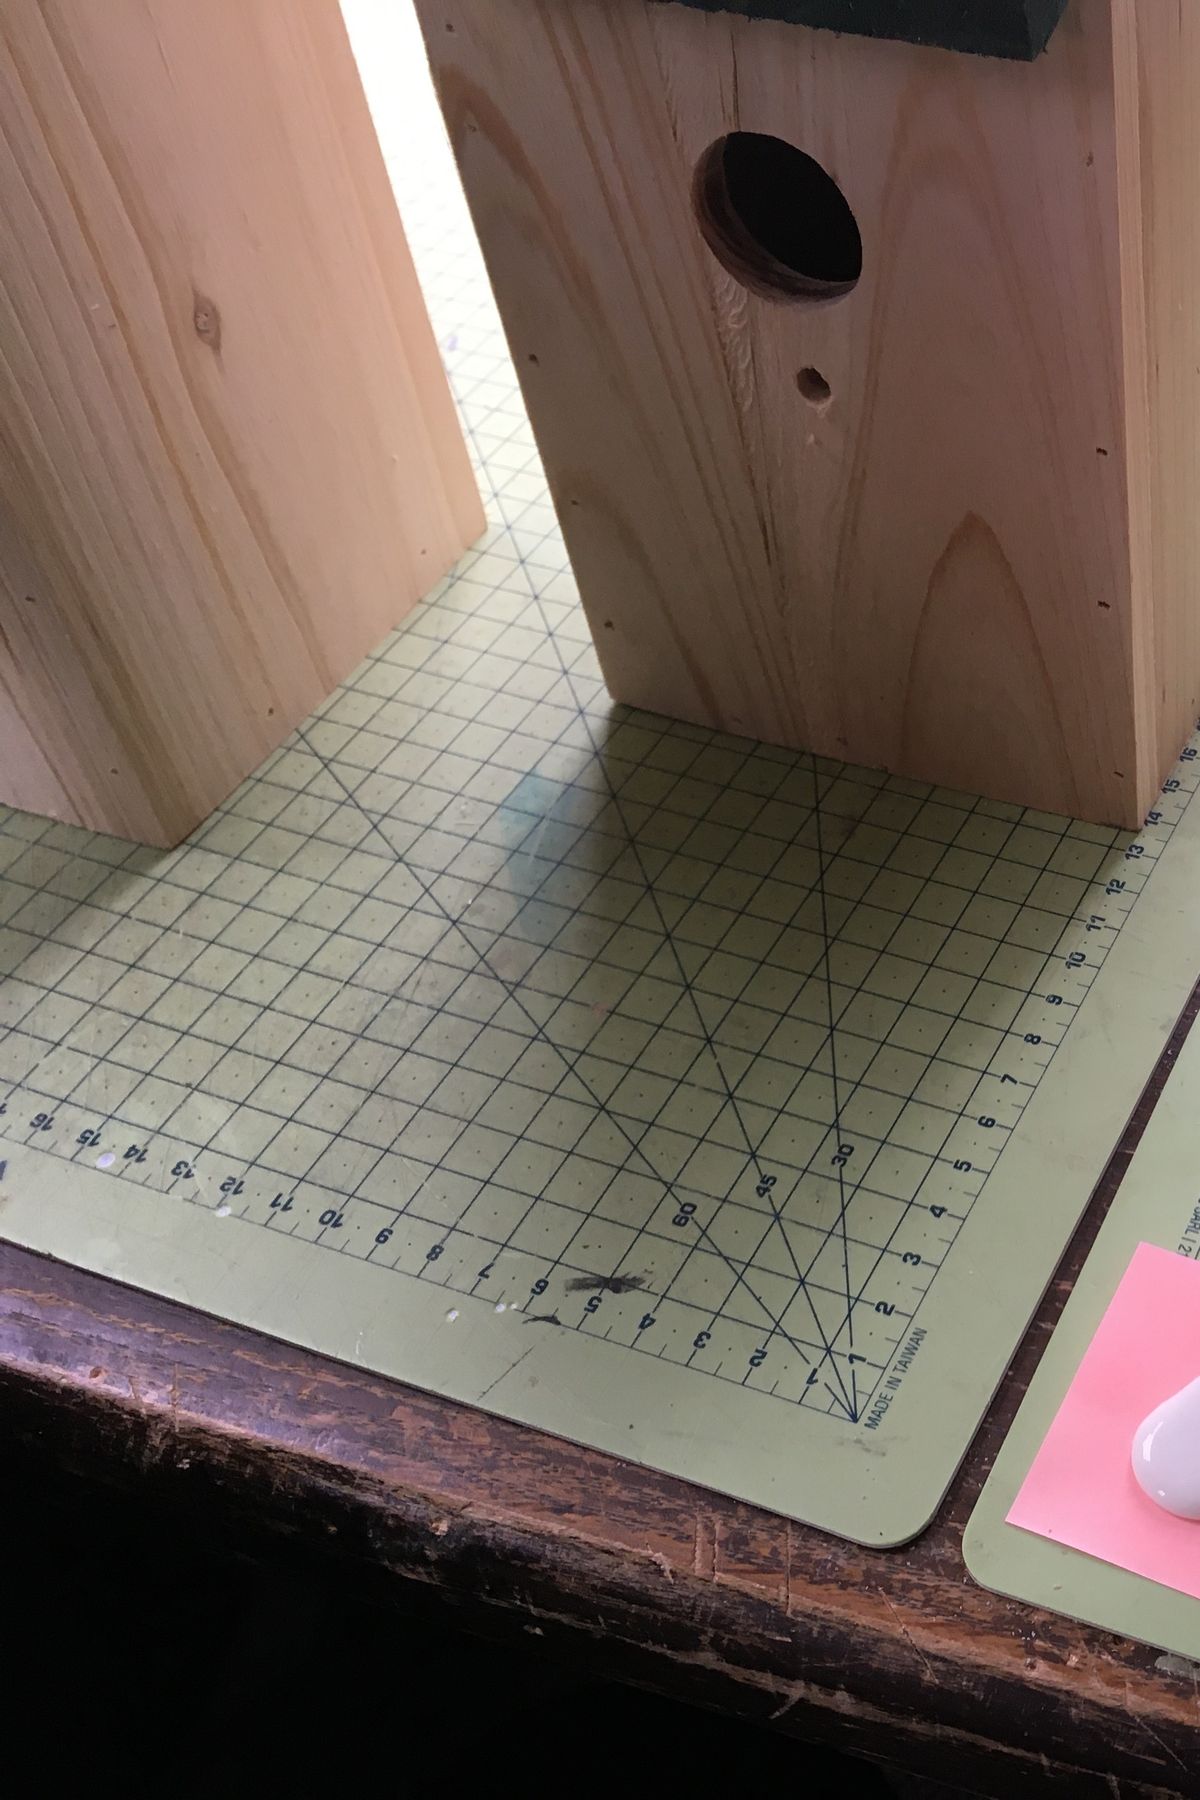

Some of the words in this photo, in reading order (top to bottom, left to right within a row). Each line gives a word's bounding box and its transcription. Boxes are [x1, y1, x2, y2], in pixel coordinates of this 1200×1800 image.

[1179, 748, 1198, 762] 16
[1161, 779, 1181, 794] 15
[1144, 810, 1163, 826] 14
[1125, 844, 1144, 860] 13
[1106, 879, 1126, 895] 12
[1086, 915, 1106, 932] 11
[1065, 952, 1086, 970] 10
[1045, 994, 1064, 1007] 9
[1024, 1033, 1042, 1046] 8
[1000, 1074, 1018, 1087] 7
[30, 1113, 54, 1131] 16
[978, 1116, 996, 1128] 6
[76, 1129, 102, 1147] 15
[123, 1144, 149, 1164] 14
[831, 1143, 856, 1167] 30
[170, 1160, 195, 1179] 13
[954, 1159, 972, 1172] 5
[219, 1176, 246, 1196] 12
[755, 1174, 779, 1197] 45
[269, 1192, 295, 1212] 11
[318, 1209, 344, 1229] 10
[672, 1202, 698, 1227] 60
[929, 1205, 948, 1218] 4
[375, 1228, 393, 1244] 9
[426, 1244, 445, 1262] 8
[902, 1252, 922, 1266] 3
[478, 1261, 495, 1280] 7
[530, 1277, 550, 1296] 6
[583, 1296, 603, 1314] 5
[875, 1301, 896, 1316] 2
[638, 1312, 656, 1332] 4
[693, 1330, 712, 1349] 3
[749, 1348, 768, 1368] 2
[848, 1353, 867, 1364] 1
[892, 1327, 928, 1373] TAIWAN
[806, 1367, 820, 1386] 1
[884, 1376, 902, 1390] IN
[864, 1392, 894, 1430] MADE
